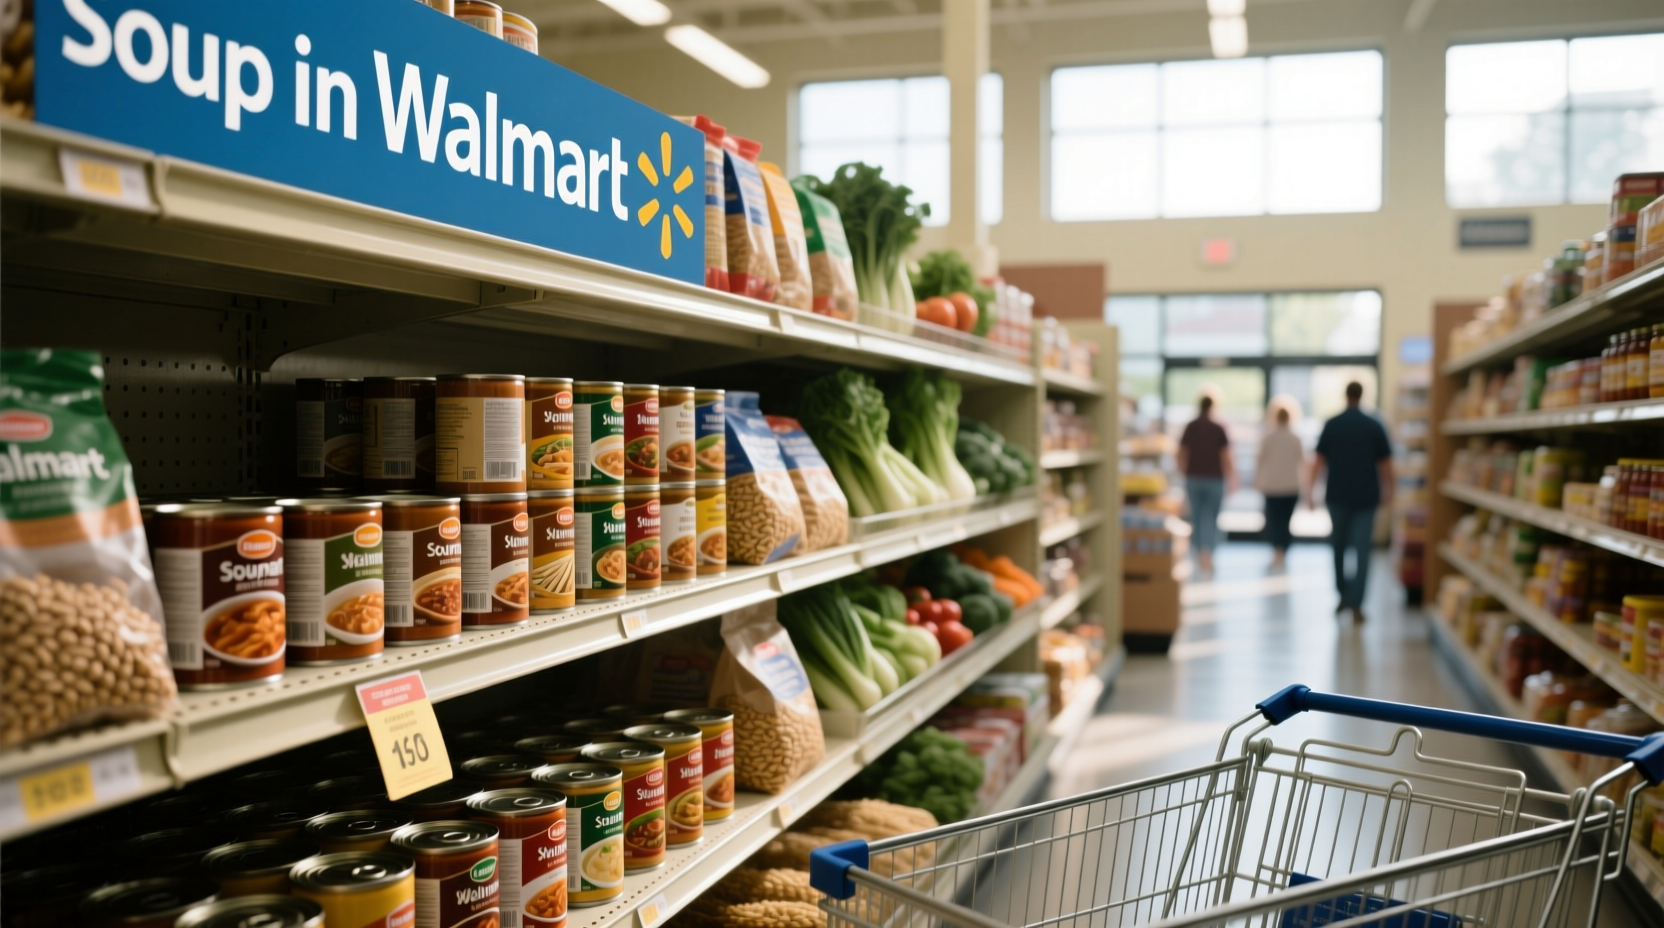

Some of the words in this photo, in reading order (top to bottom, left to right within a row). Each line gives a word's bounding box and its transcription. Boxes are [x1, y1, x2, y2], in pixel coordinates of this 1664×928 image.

[61, 0, 274, 131] Soup
[294, 34, 358, 140] in
[373, 50, 629, 221] Walmart
[391, 732, 430, 770] 150
